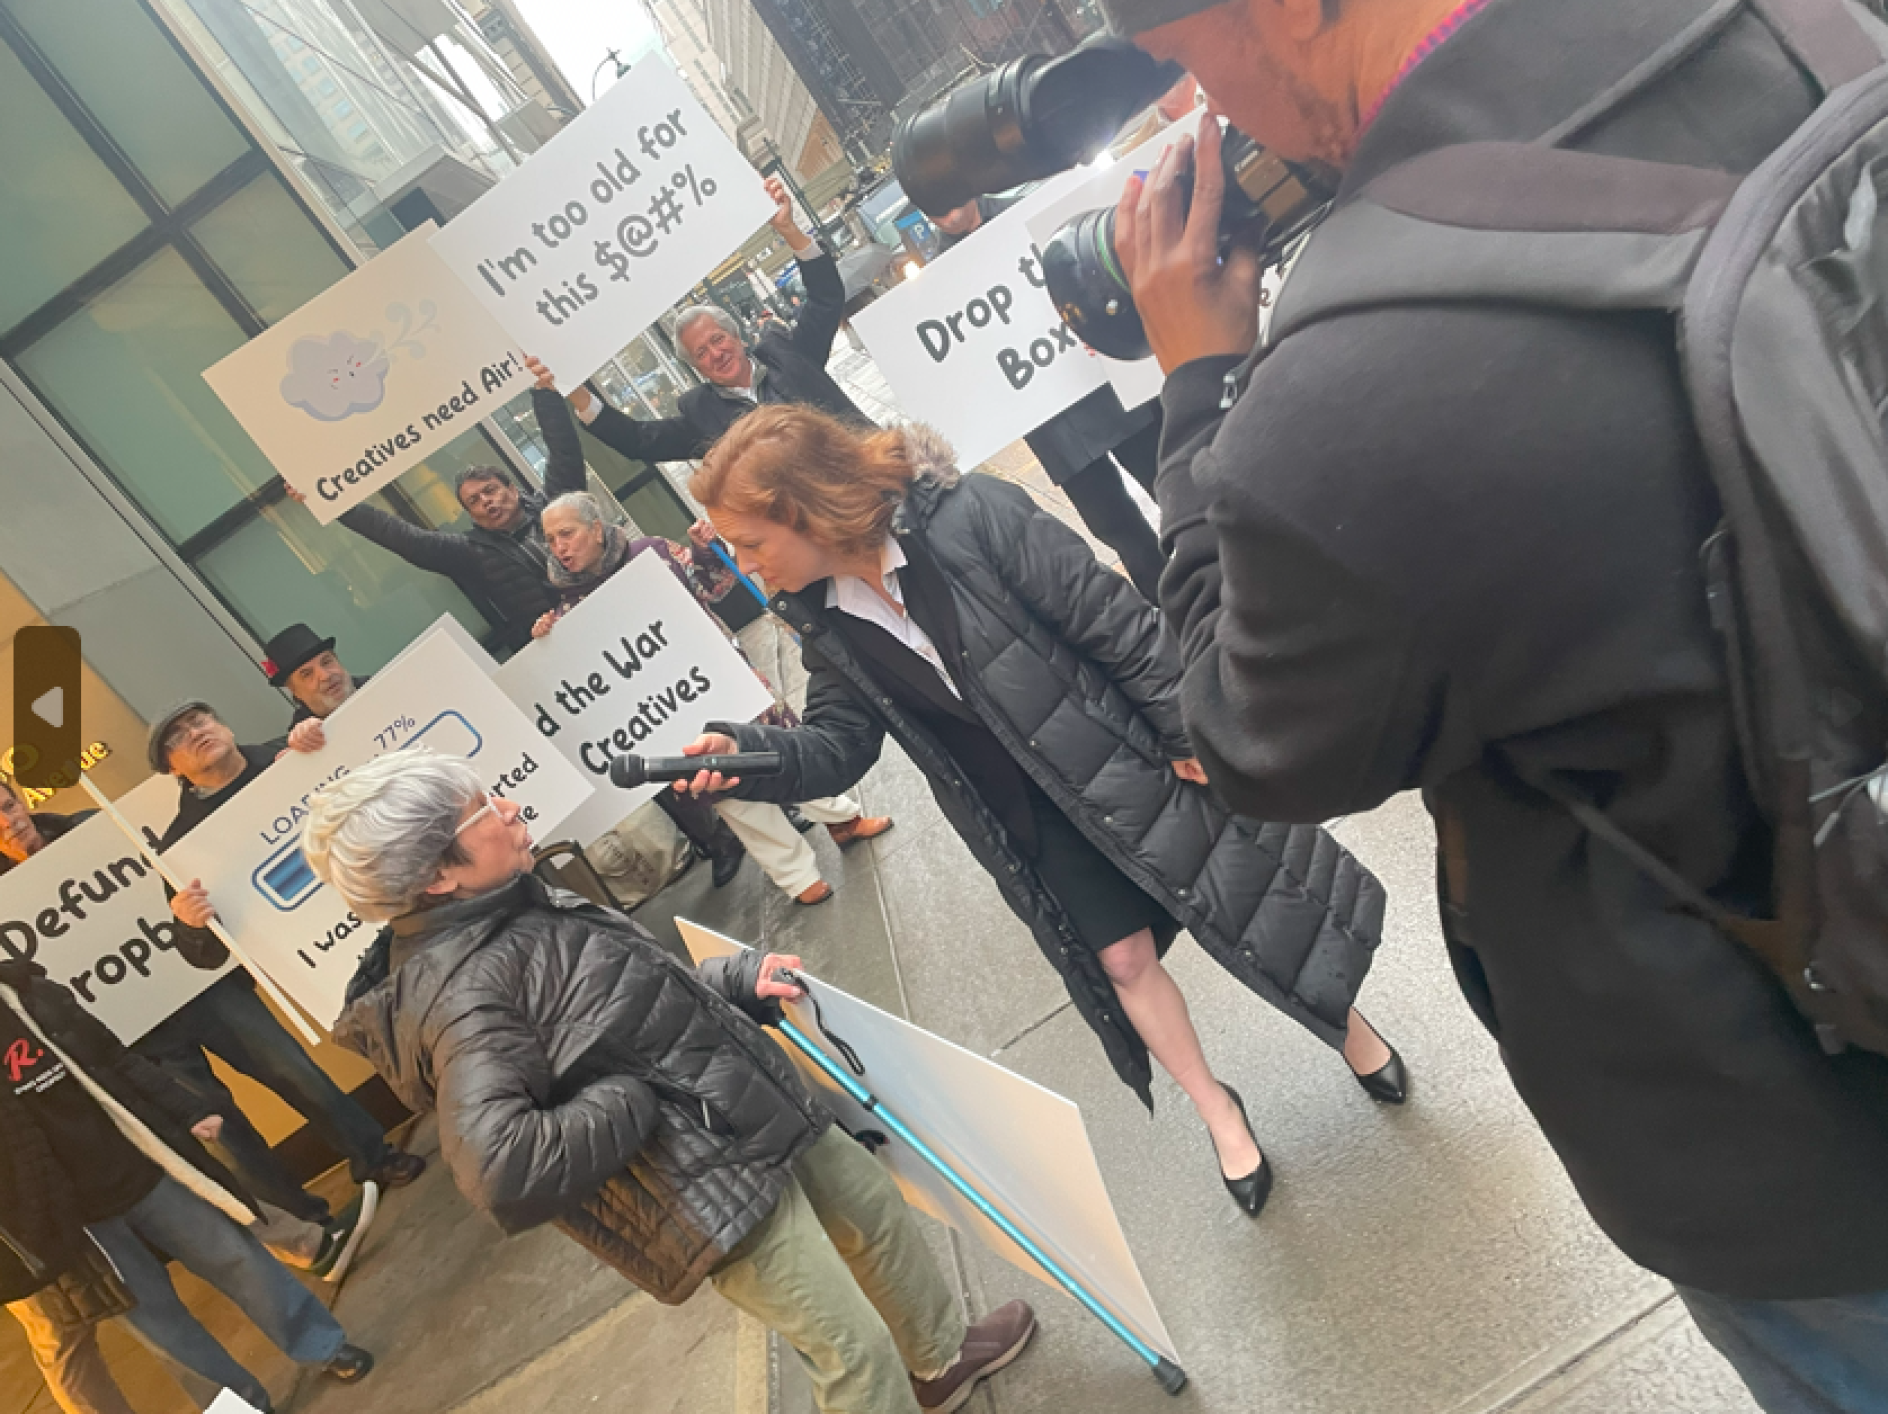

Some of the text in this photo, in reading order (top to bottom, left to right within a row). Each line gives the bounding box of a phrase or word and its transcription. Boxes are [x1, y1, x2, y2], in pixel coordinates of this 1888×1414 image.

[477, 108, 688, 296] I'm too old for
[536, 164, 717, 325] this $@#%
[916, 285, 1012, 363] Drop
[997, 322, 1077, 390] Box
[316, 351, 524, 501] Creatives need Air!
[554, 672, 611, 715] the
[602, 619, 669, 679] War
[579, 665, 711, 775] Creatives
[373, 715, 416, 748] 77%
[297, 949, 316, 969] I
[313, 911, 363, 952] was
[489, 752, 539, 797] rted
